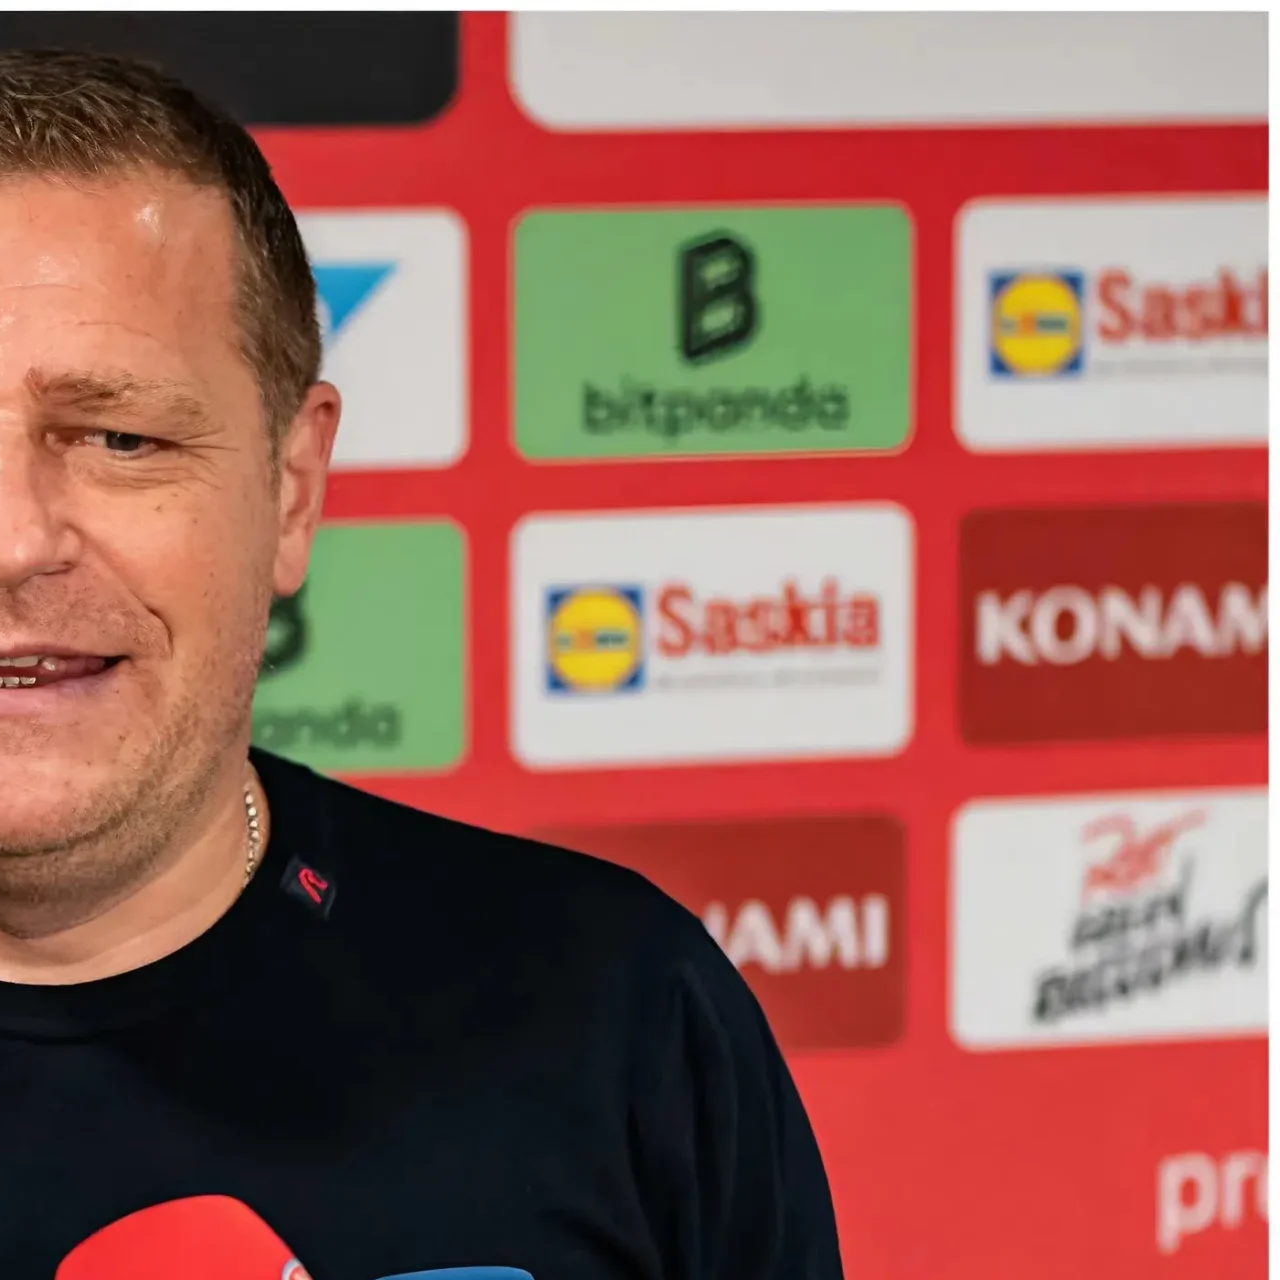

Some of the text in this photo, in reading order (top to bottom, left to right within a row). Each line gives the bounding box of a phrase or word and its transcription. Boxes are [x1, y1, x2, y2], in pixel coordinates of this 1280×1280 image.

[582, 374, 850, 443] bitpanda
[657, 581, 881, 657] Saskia
[1157, 1151, 1268, 1254] pr
